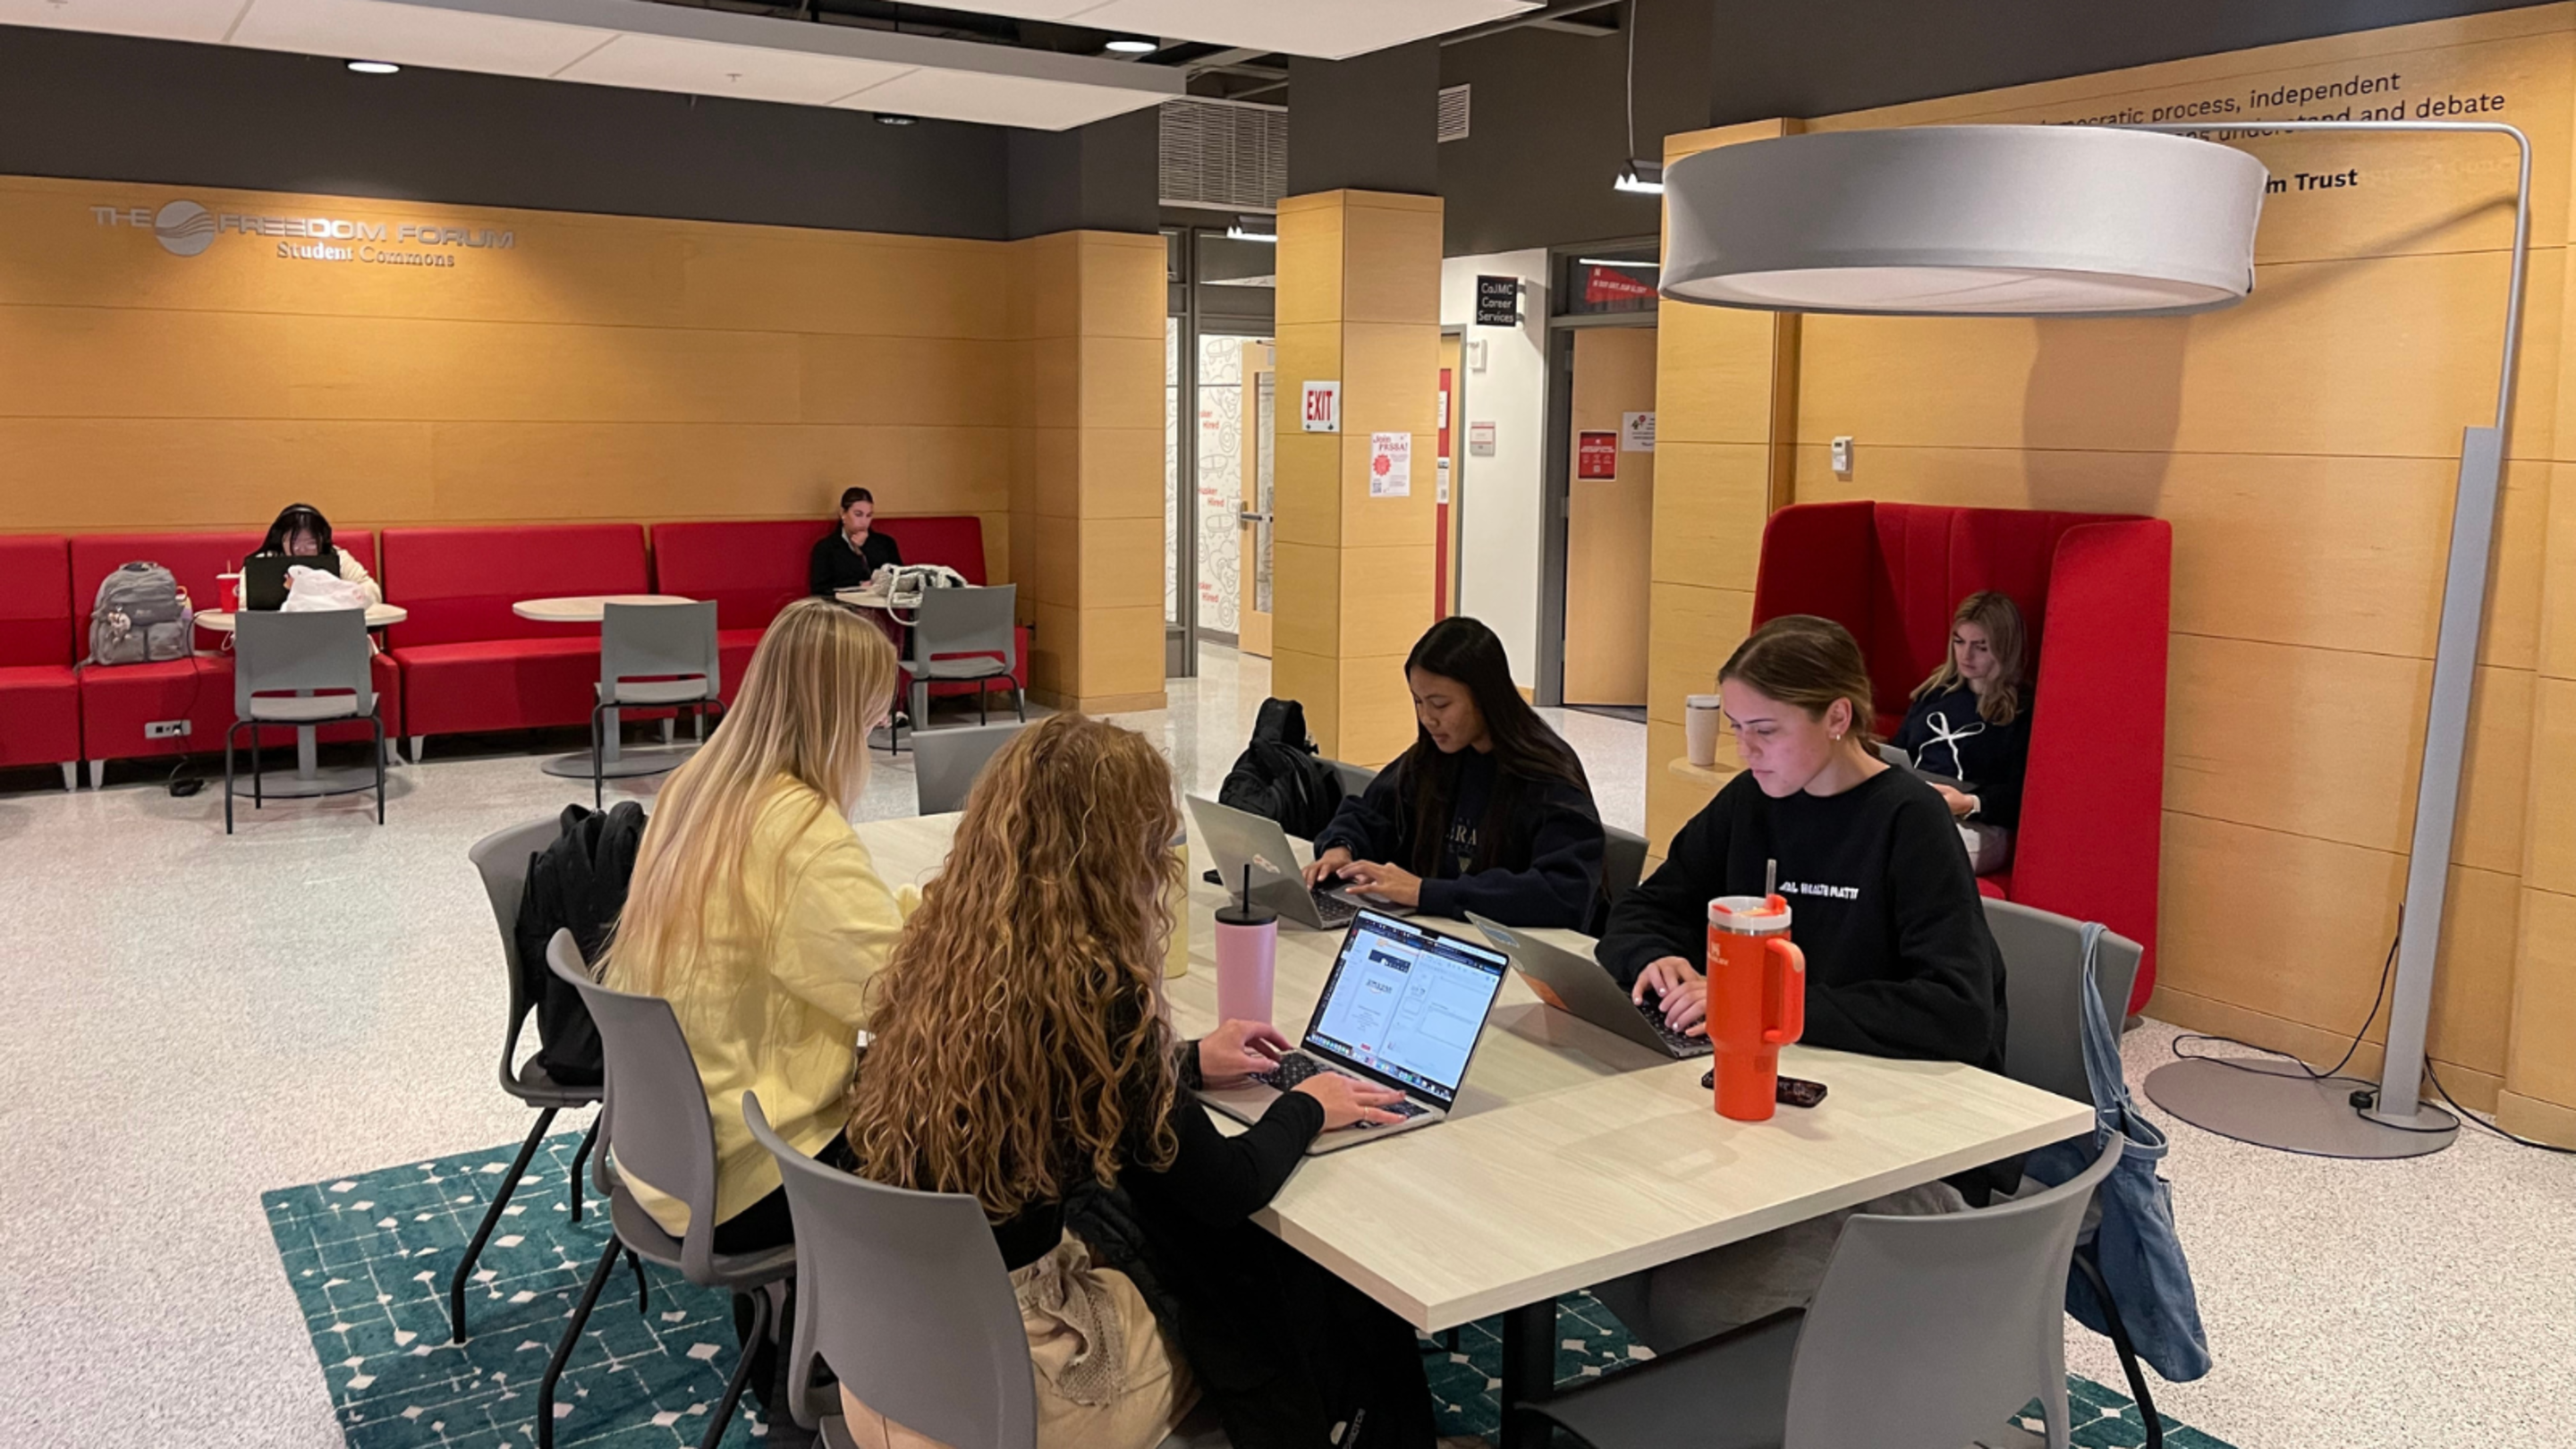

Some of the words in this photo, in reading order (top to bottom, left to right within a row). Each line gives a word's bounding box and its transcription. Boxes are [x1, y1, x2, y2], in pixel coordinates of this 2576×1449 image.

[2152, 97, 2241, 123] process,
[2249, 72, 2401, 108] independent
[2361, 100, 2406, 121] and
[2416, 93, 2505, 118] debate
[2295, 169, 2359, 191] Trust
[90, 206, 153, 227] THE
[219, 214, 386, 242] FREEDOM
[397, 225, 514, 249] FORUM
[277, 242, 354, 261] Student
[359, 246, 455, 267] Commons
[1482, 296, 1513, 309] Career
[1479, 310, 1514, 323] Services
[1307, 390, 1333, 420] EXIT
